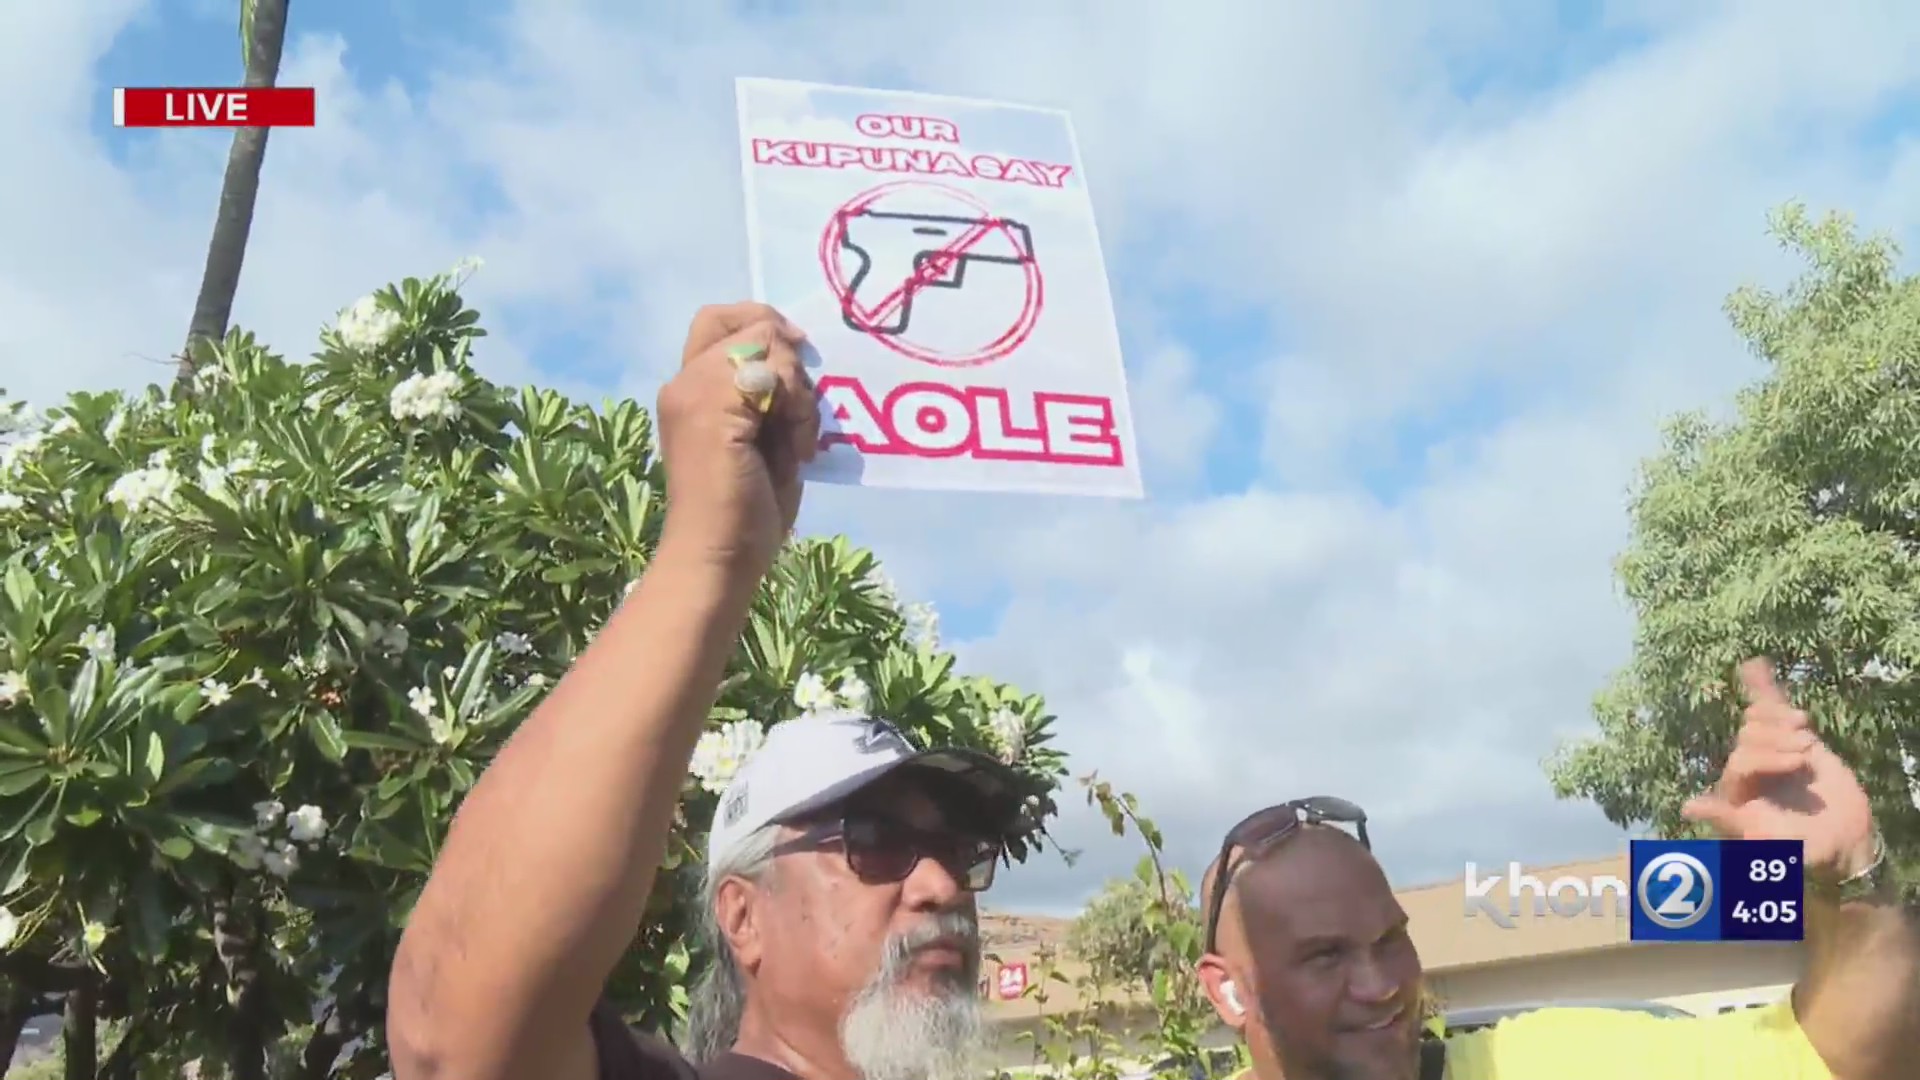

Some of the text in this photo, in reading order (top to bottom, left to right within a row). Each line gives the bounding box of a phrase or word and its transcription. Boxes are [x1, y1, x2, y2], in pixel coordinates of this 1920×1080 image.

[856, 114, 959, 143] OUR
[752, 138, 1074, 188] KUPUNA SAY
[816, 375, 1124, 467] AOLE
